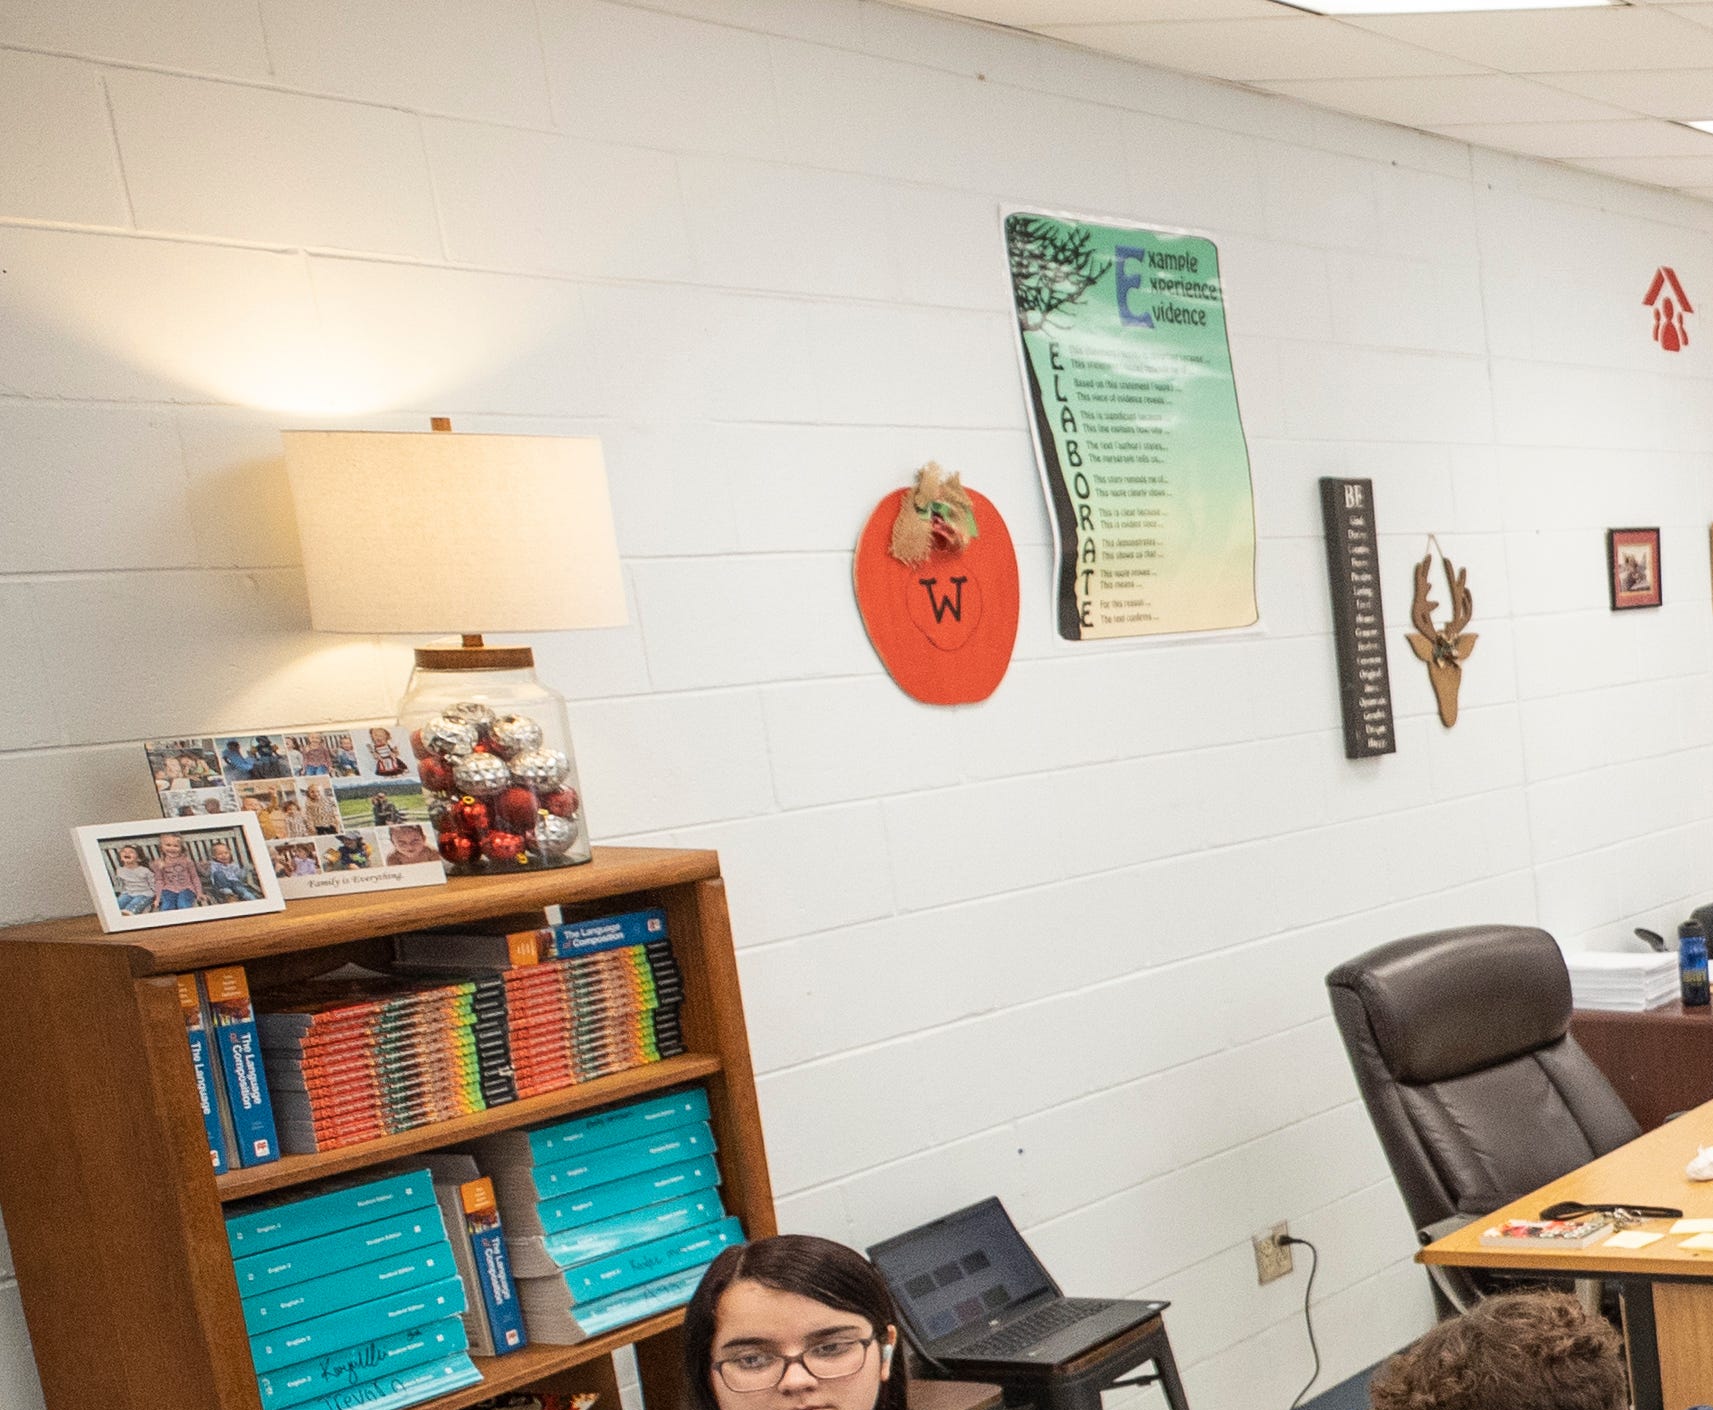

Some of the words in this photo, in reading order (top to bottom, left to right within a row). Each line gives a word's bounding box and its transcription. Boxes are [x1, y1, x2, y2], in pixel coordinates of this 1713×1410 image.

[1152, 301, 1206, 326] vidence
[1344, 484, 1363, 508] BE
[919, 576, 967, 624] W
[563, 930, 579, 940] The
[580, 924, 620, 936] Language
[190, 1041, 202, 1061] The
[240, 1033, 251, 1052] The
[195, 1063, 212, 1116] Language
[232, 1044, 252, 1110] Composition
[245, 1053, 262, 1105] Language
[484, 1248, 503, 1305] Composition
[491, 1237, 500, 1254] The
[496, 1255, 511, 1300] Language
